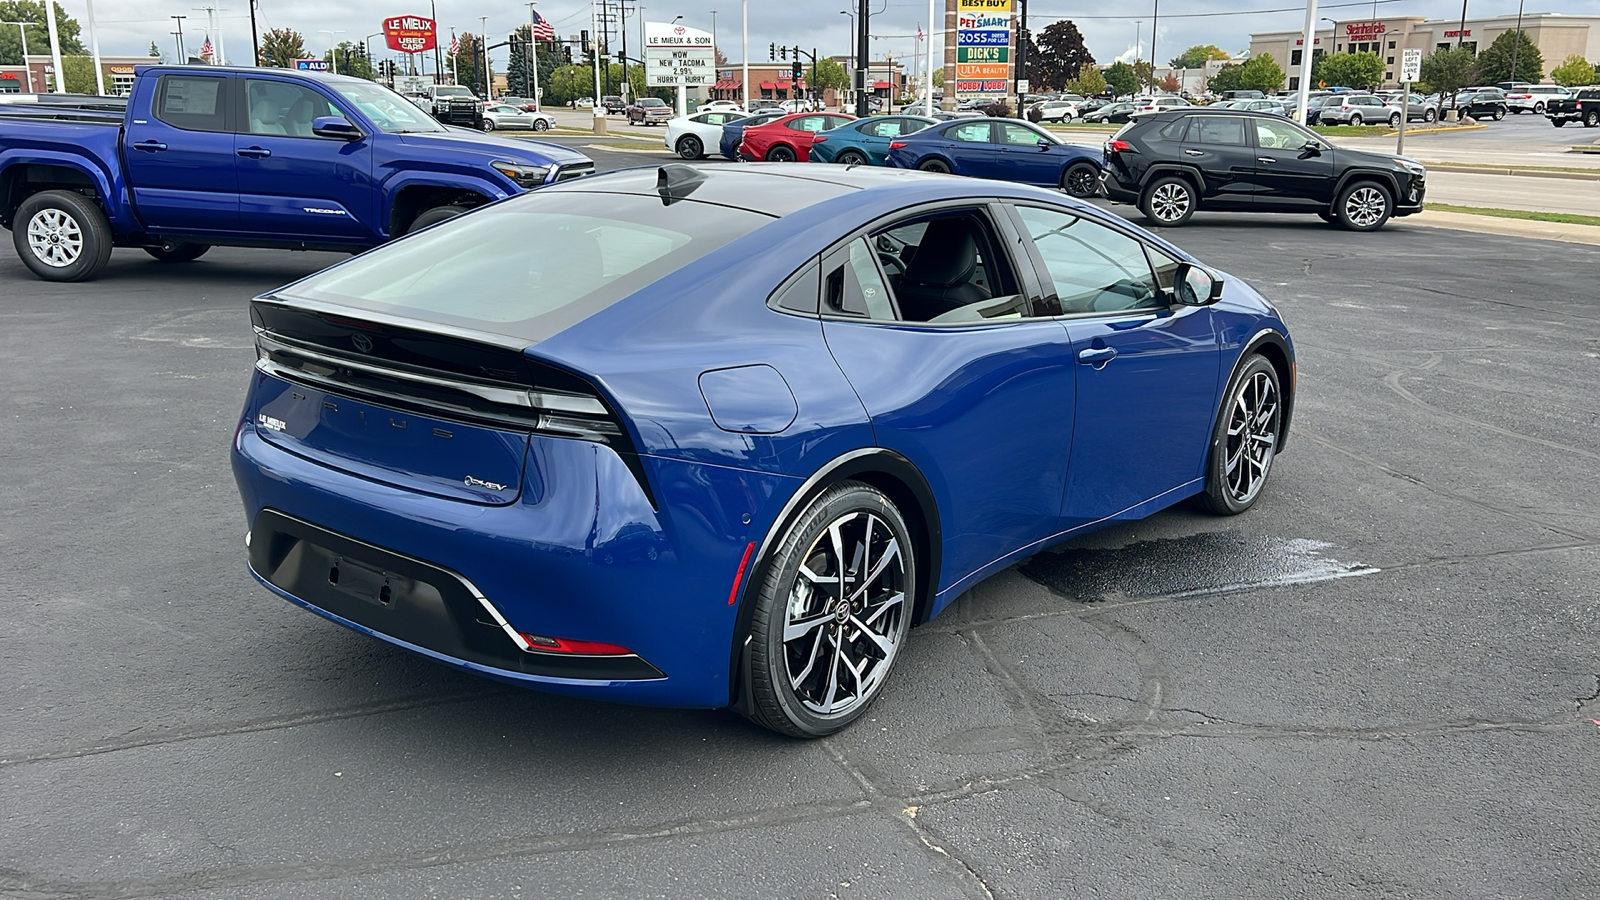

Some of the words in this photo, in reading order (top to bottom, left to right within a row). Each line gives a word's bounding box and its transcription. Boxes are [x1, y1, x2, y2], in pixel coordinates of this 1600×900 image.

[389, 20, 400, 30] LE
[402, 18, 432, 30] MIEUX
[959, 33, 987, 43] ROSS
[1443, 29, 1471, 38] FURNITRE
[672, 51, 688, 59] WOW
[967, 47, 999, 59] DICK'S
[673, 67, 693, 75] 2.99%
[960, 65, 982, 74] ULTA
[657, 76, 679, 84] HURRY
[685, 76, 706, 84] HURRY
[957, 80, 982, 91] HOBBY
[984, 80, 1007, 91] LOBBY
[291, 391, 453, 440] PRIUS
[259, 413, 267, 423] LE
[267, 416, 287, 430] MIEUX
